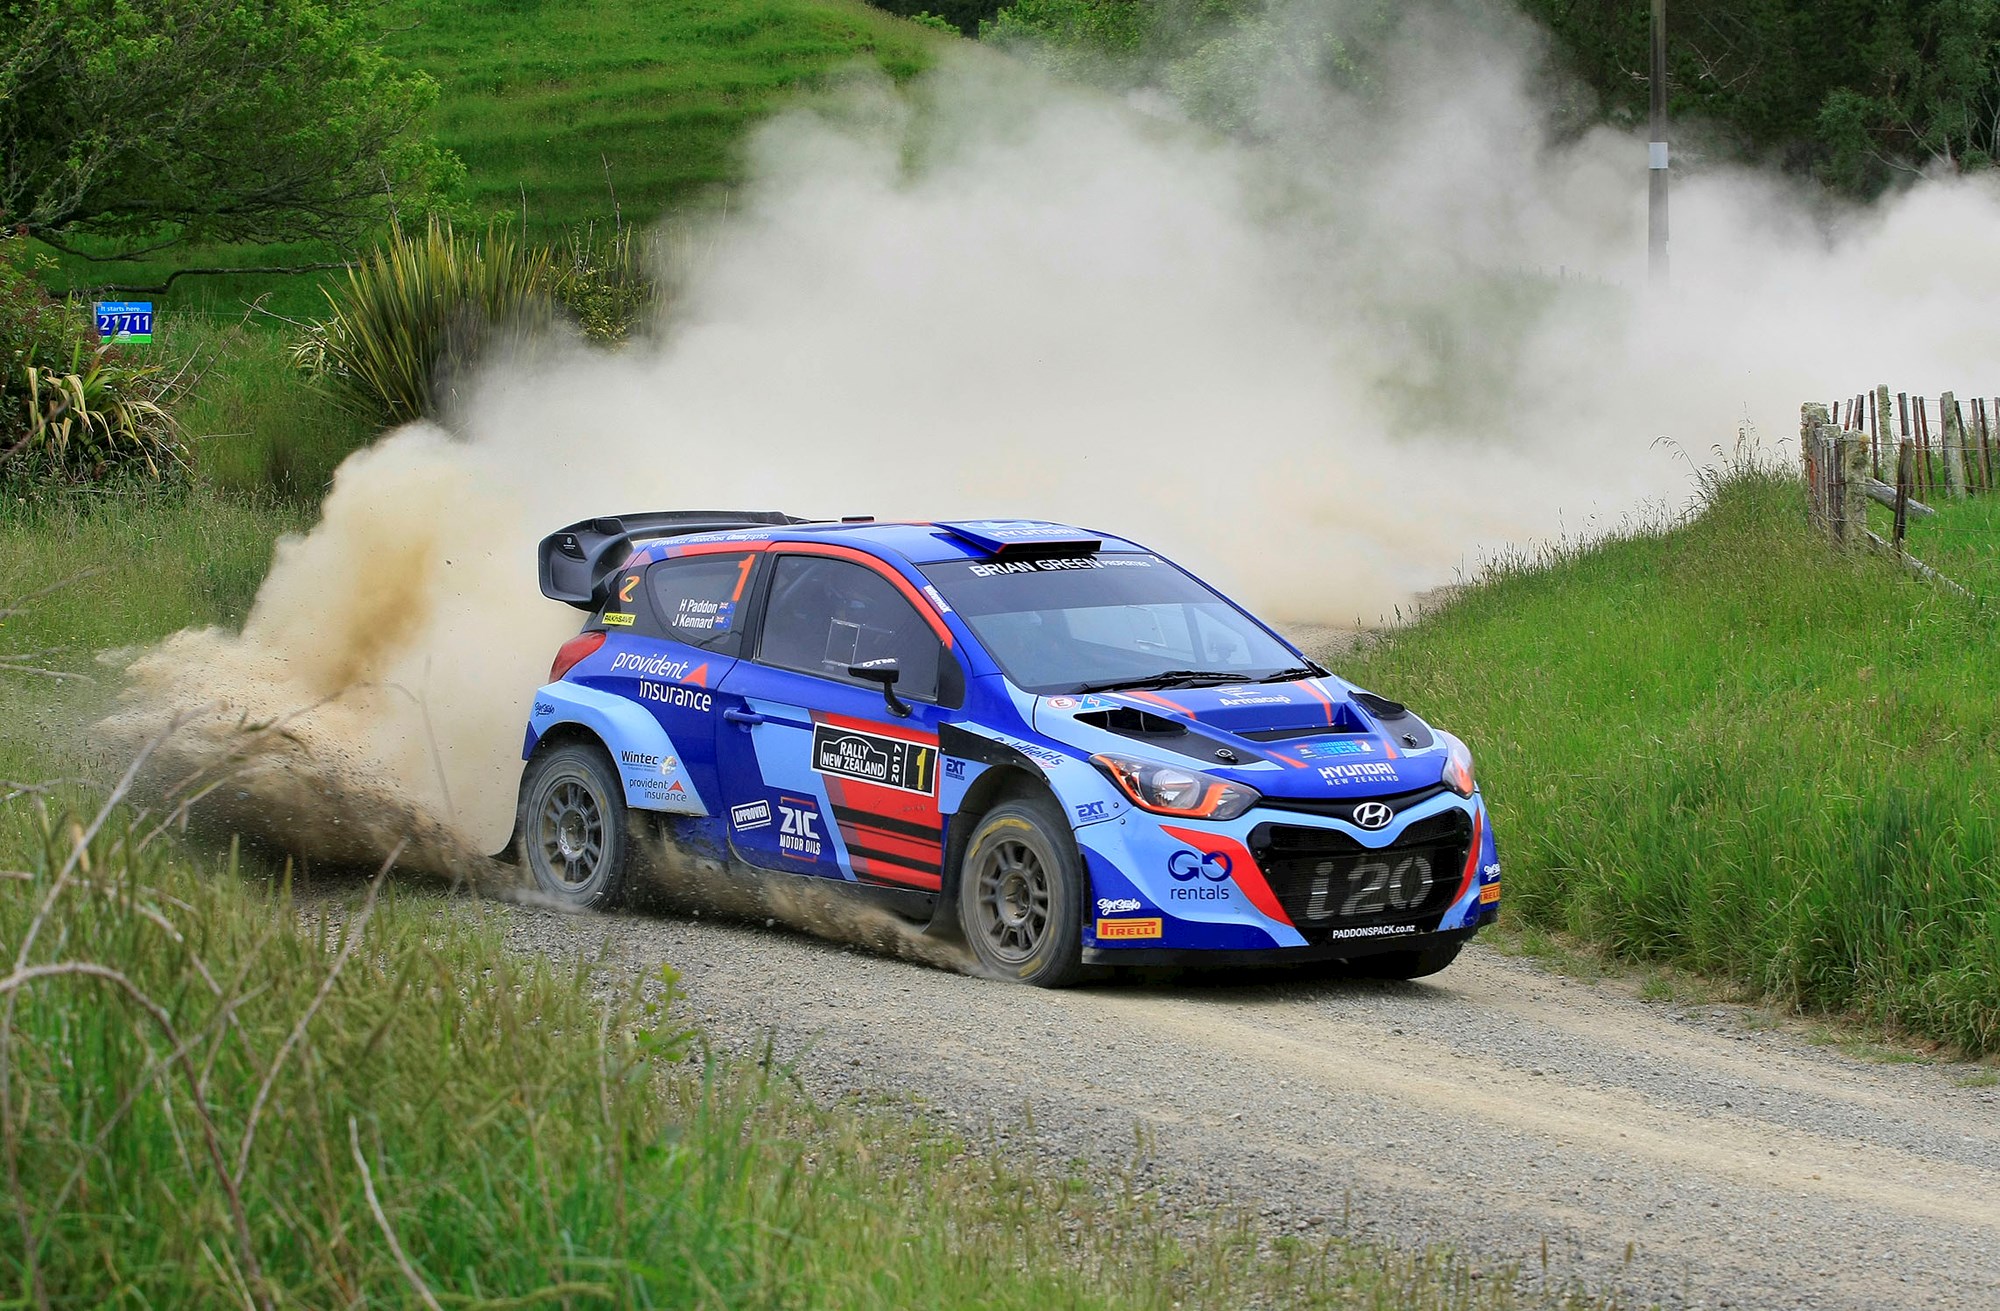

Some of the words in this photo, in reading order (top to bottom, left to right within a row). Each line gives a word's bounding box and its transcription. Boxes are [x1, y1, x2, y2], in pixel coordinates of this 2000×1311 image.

[100, 315, 149, 331] 21711
[968, 561, 1037, 577] BRIAN
[1035, 557, 1105, 571] GREEN
[732, 554, 756, 602] 1
[679, 599, 688, 612] H
[689, 600, 718, 614] Paddon
[672, 614, 679, 627] J
[679, 614, 714, 629] Kennard
[610, 652, 688, 680] provident
[639, 675, 712, 712] insurance
[1219, 695, 1291, 706] Armacup
[621, 750, 659, 765] Wintec
[840, 742, 869, 760] RALLY
[822, 752, 842, 769] NEW
[843, 756, 884, 777] ZEALAND
[891, 744, 902, 783] 2017
[916, 748, 927, 790] 1
[1317, 763, 1396, 779] HYUNDAI
[629, 778, 668, 790] provident
[1326, 778, 1349, 786] NEW
[1354, 775, 1400, 783] ZEALAND
[645, 789, 687, 802] insurance
[735, 805, 768, 823] APPROVED
[778, 805, 821, 840] ZIC
[780, 834, 804, 852] MOTOR
[805, 840, 821, 856] OILS
[1167, 850, 1233, 882] GO
[1170, 885, 1230, 900] rentals
[1102, 921, 1156, 936] PIRELLI
[1332, 925, 1416, 939] PADDONSPACK.co.nz
